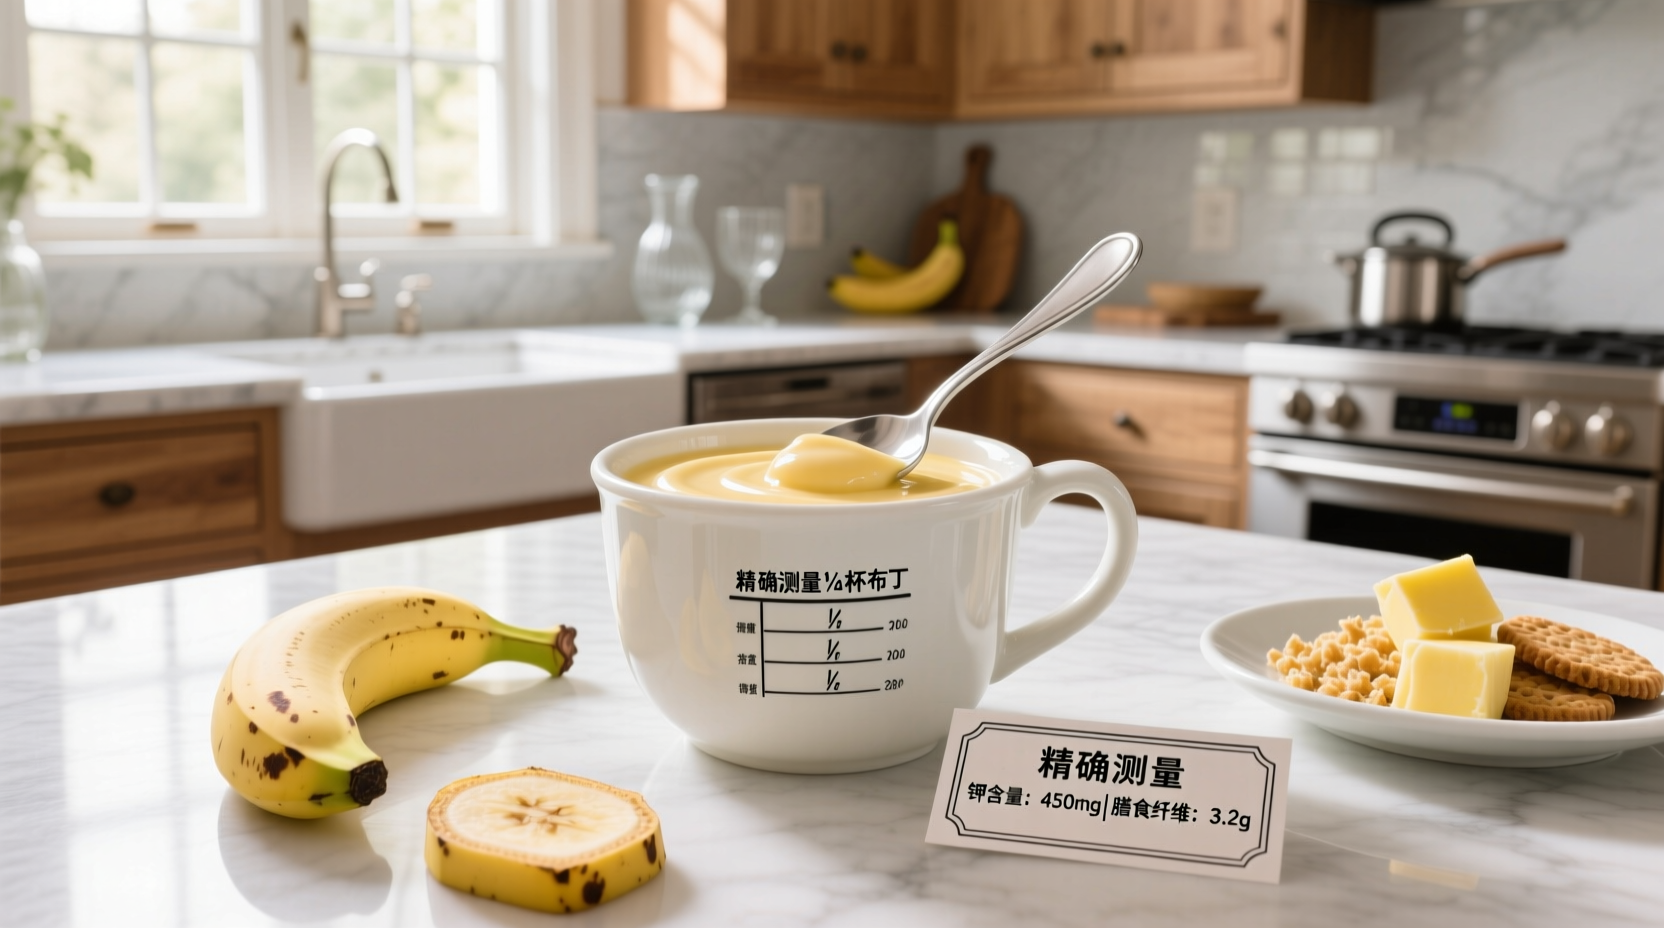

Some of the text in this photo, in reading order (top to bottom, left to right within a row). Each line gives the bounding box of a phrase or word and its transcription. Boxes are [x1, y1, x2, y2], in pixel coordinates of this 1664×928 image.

[1038, 746, 1185, 789] 精确测量
[1209, 807, 1252, 832] 3.2g
